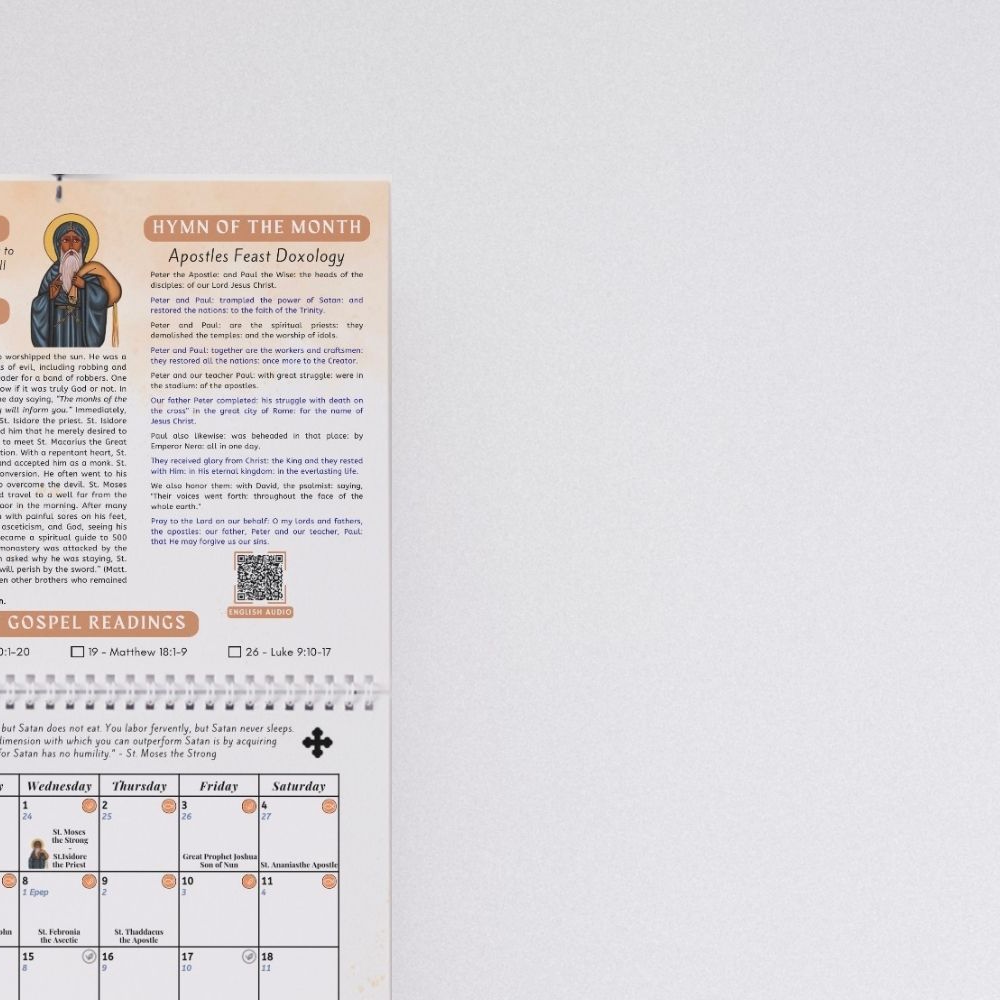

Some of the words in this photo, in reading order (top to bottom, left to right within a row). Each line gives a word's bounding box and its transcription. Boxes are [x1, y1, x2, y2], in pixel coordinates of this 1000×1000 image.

[153, 219, 209, 234] HYMN
[216, 219, 241, 234] OF
[247, 219, 284, 234] THE
[291, 219, 361, 234] MONTH
[4, 246, 15, 256] to
[168, 247, 229, 268] Apostles
[234, 247, 271, 263] Feast
[276, 247, 345, 268] Doxology
[150, 396, 166, 404] Our
[167, 396, 191, 404] father
[275, 396, 307, 406] struggle
[227, 607, 263, 616] ENGLISH
[265, 607, 294, 617] AUDIO
[7, 614, 82, 630] GOSPEL
[88, 614, 186, 630] READINGS
[88, 647, 99, 657] 19
[109, 646, 156, 657] Matthew
[245, 647, 259, 657] 26
[270, 646, 294, 657] Luke
[1, 722, 16, 733] but
[18, 722, 44, 733] Satan
[46, 722, 66, 733] does
[69, 725, 84, 733] not
[105, 723, 122, 733] You
[124, 723, 148, 733] labor
[148, 722, 192, 736] fervently,
[194, 722, 209, 733] but
[211, 723, 237, 733] Satan
[27, 780, 92, 794] Wednesday
[112, 780, 167, 794] Thursday
[199, 780, 239, 794] Friday
[272, 780, 326, 794] Saturday
[22, 800, 28, 810] 1
[102, 800, 108, 810] 2
[181, 800, 188, 810] 3
[261, 800, 268, 810] 4
[182, 952, 194, 961] 17
